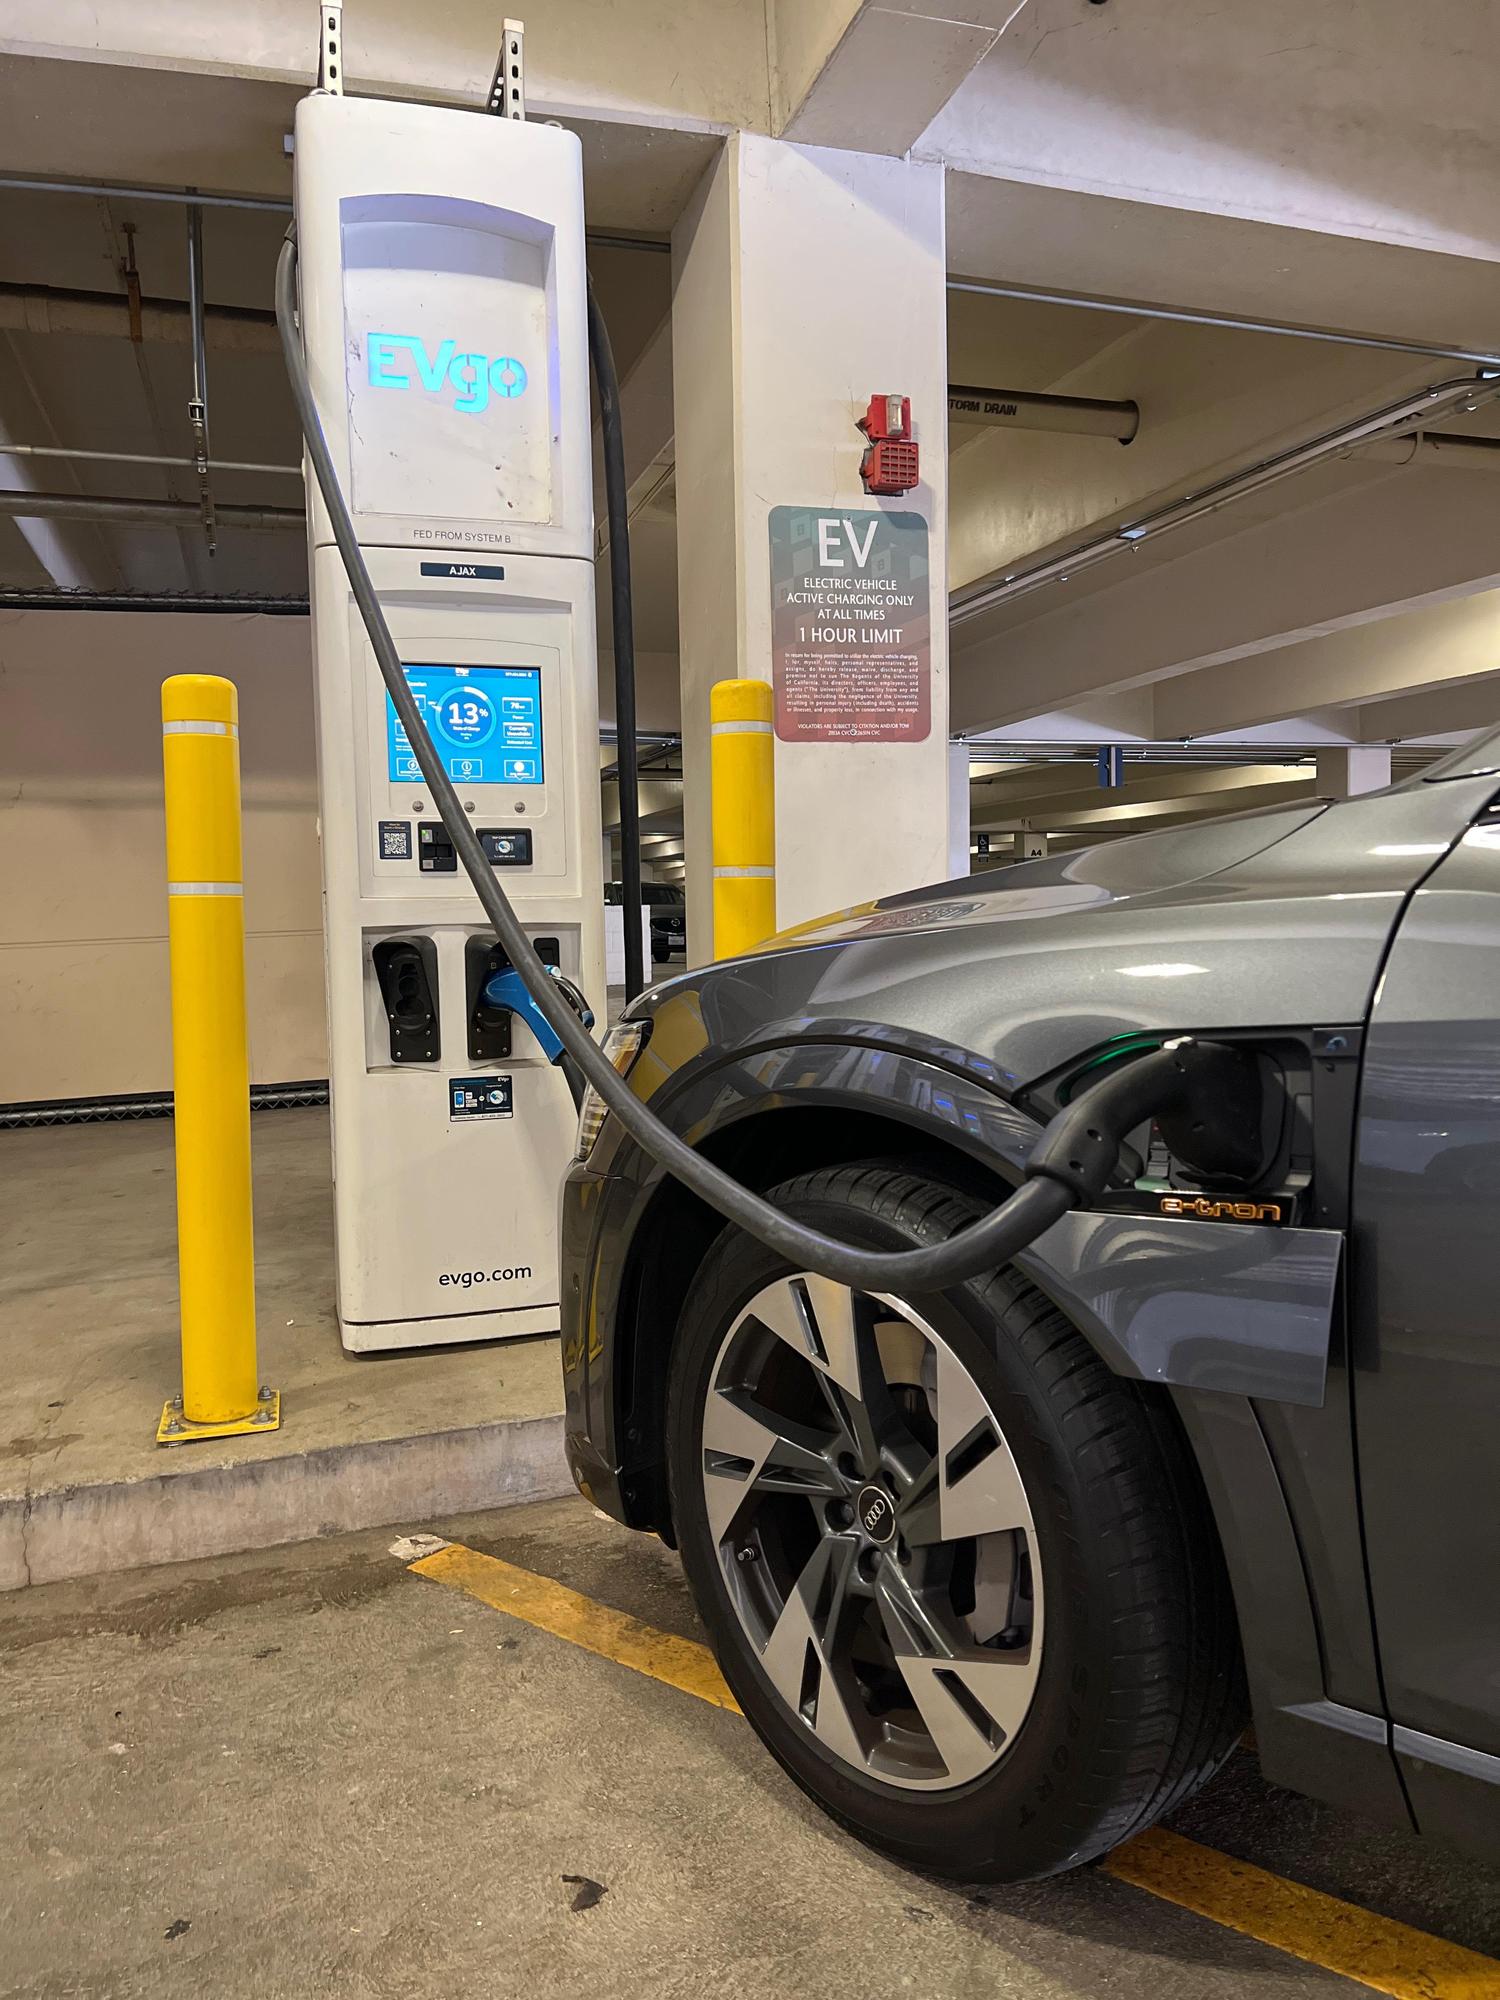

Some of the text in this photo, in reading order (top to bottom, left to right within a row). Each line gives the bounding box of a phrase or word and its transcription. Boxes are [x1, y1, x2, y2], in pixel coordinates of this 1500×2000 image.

[367, 332, 528, 413] EVgo
[949, 399, 1017, 416] TORM DRAIN
[413, 529, 511, 543] FED FROM SYSTEM B
[818, 518, 879, 568] EV
[449, 566, 476, 576] AJAX
[804, 578, 897, 591] ELECTRIC VEHICLE
[787, 593, 914, 606] ACTIVE CHARGING ONLY
[818, 608, 886, 621] AT ALL TIMES
[800, 627, 903, 643] 1 HOUR LIMIT
[1030, 848, 1042, 856] A4
[1160, 1198, 1281, 1221] e-tron
[439, 1267, 532, 1288] evgo.com
